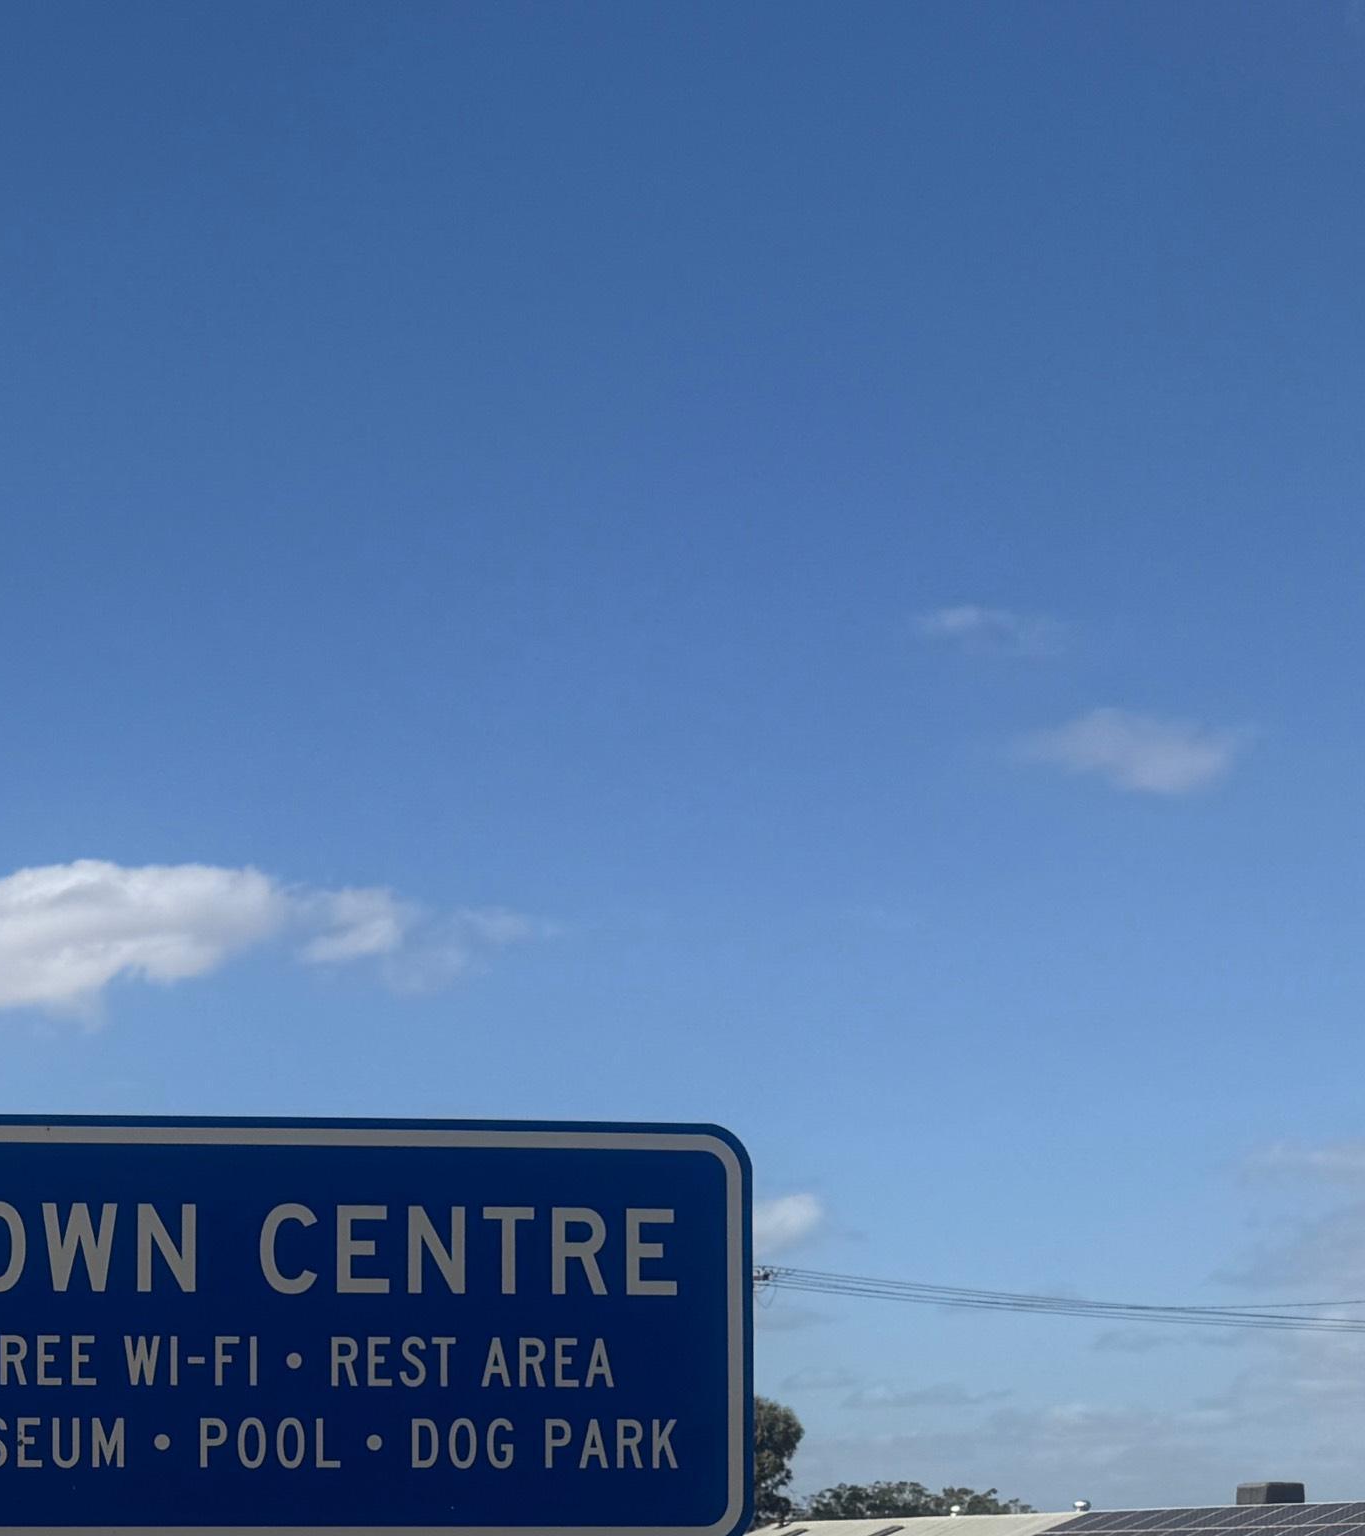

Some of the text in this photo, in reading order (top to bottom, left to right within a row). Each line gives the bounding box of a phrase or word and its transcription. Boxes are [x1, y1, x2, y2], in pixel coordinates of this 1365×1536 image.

[260, 1204, 677, 1296] CENTRE
[124, 1336, 257, 1386] WI-FI
[332, 1337, 455, 1388] REST
[482, 1338, 613, 1388] AREA
[200, 1418, 340, 1469] POOL
[412, 1419, 513, 1469] DOG
[546, 1419, 677, 1469] PARK
